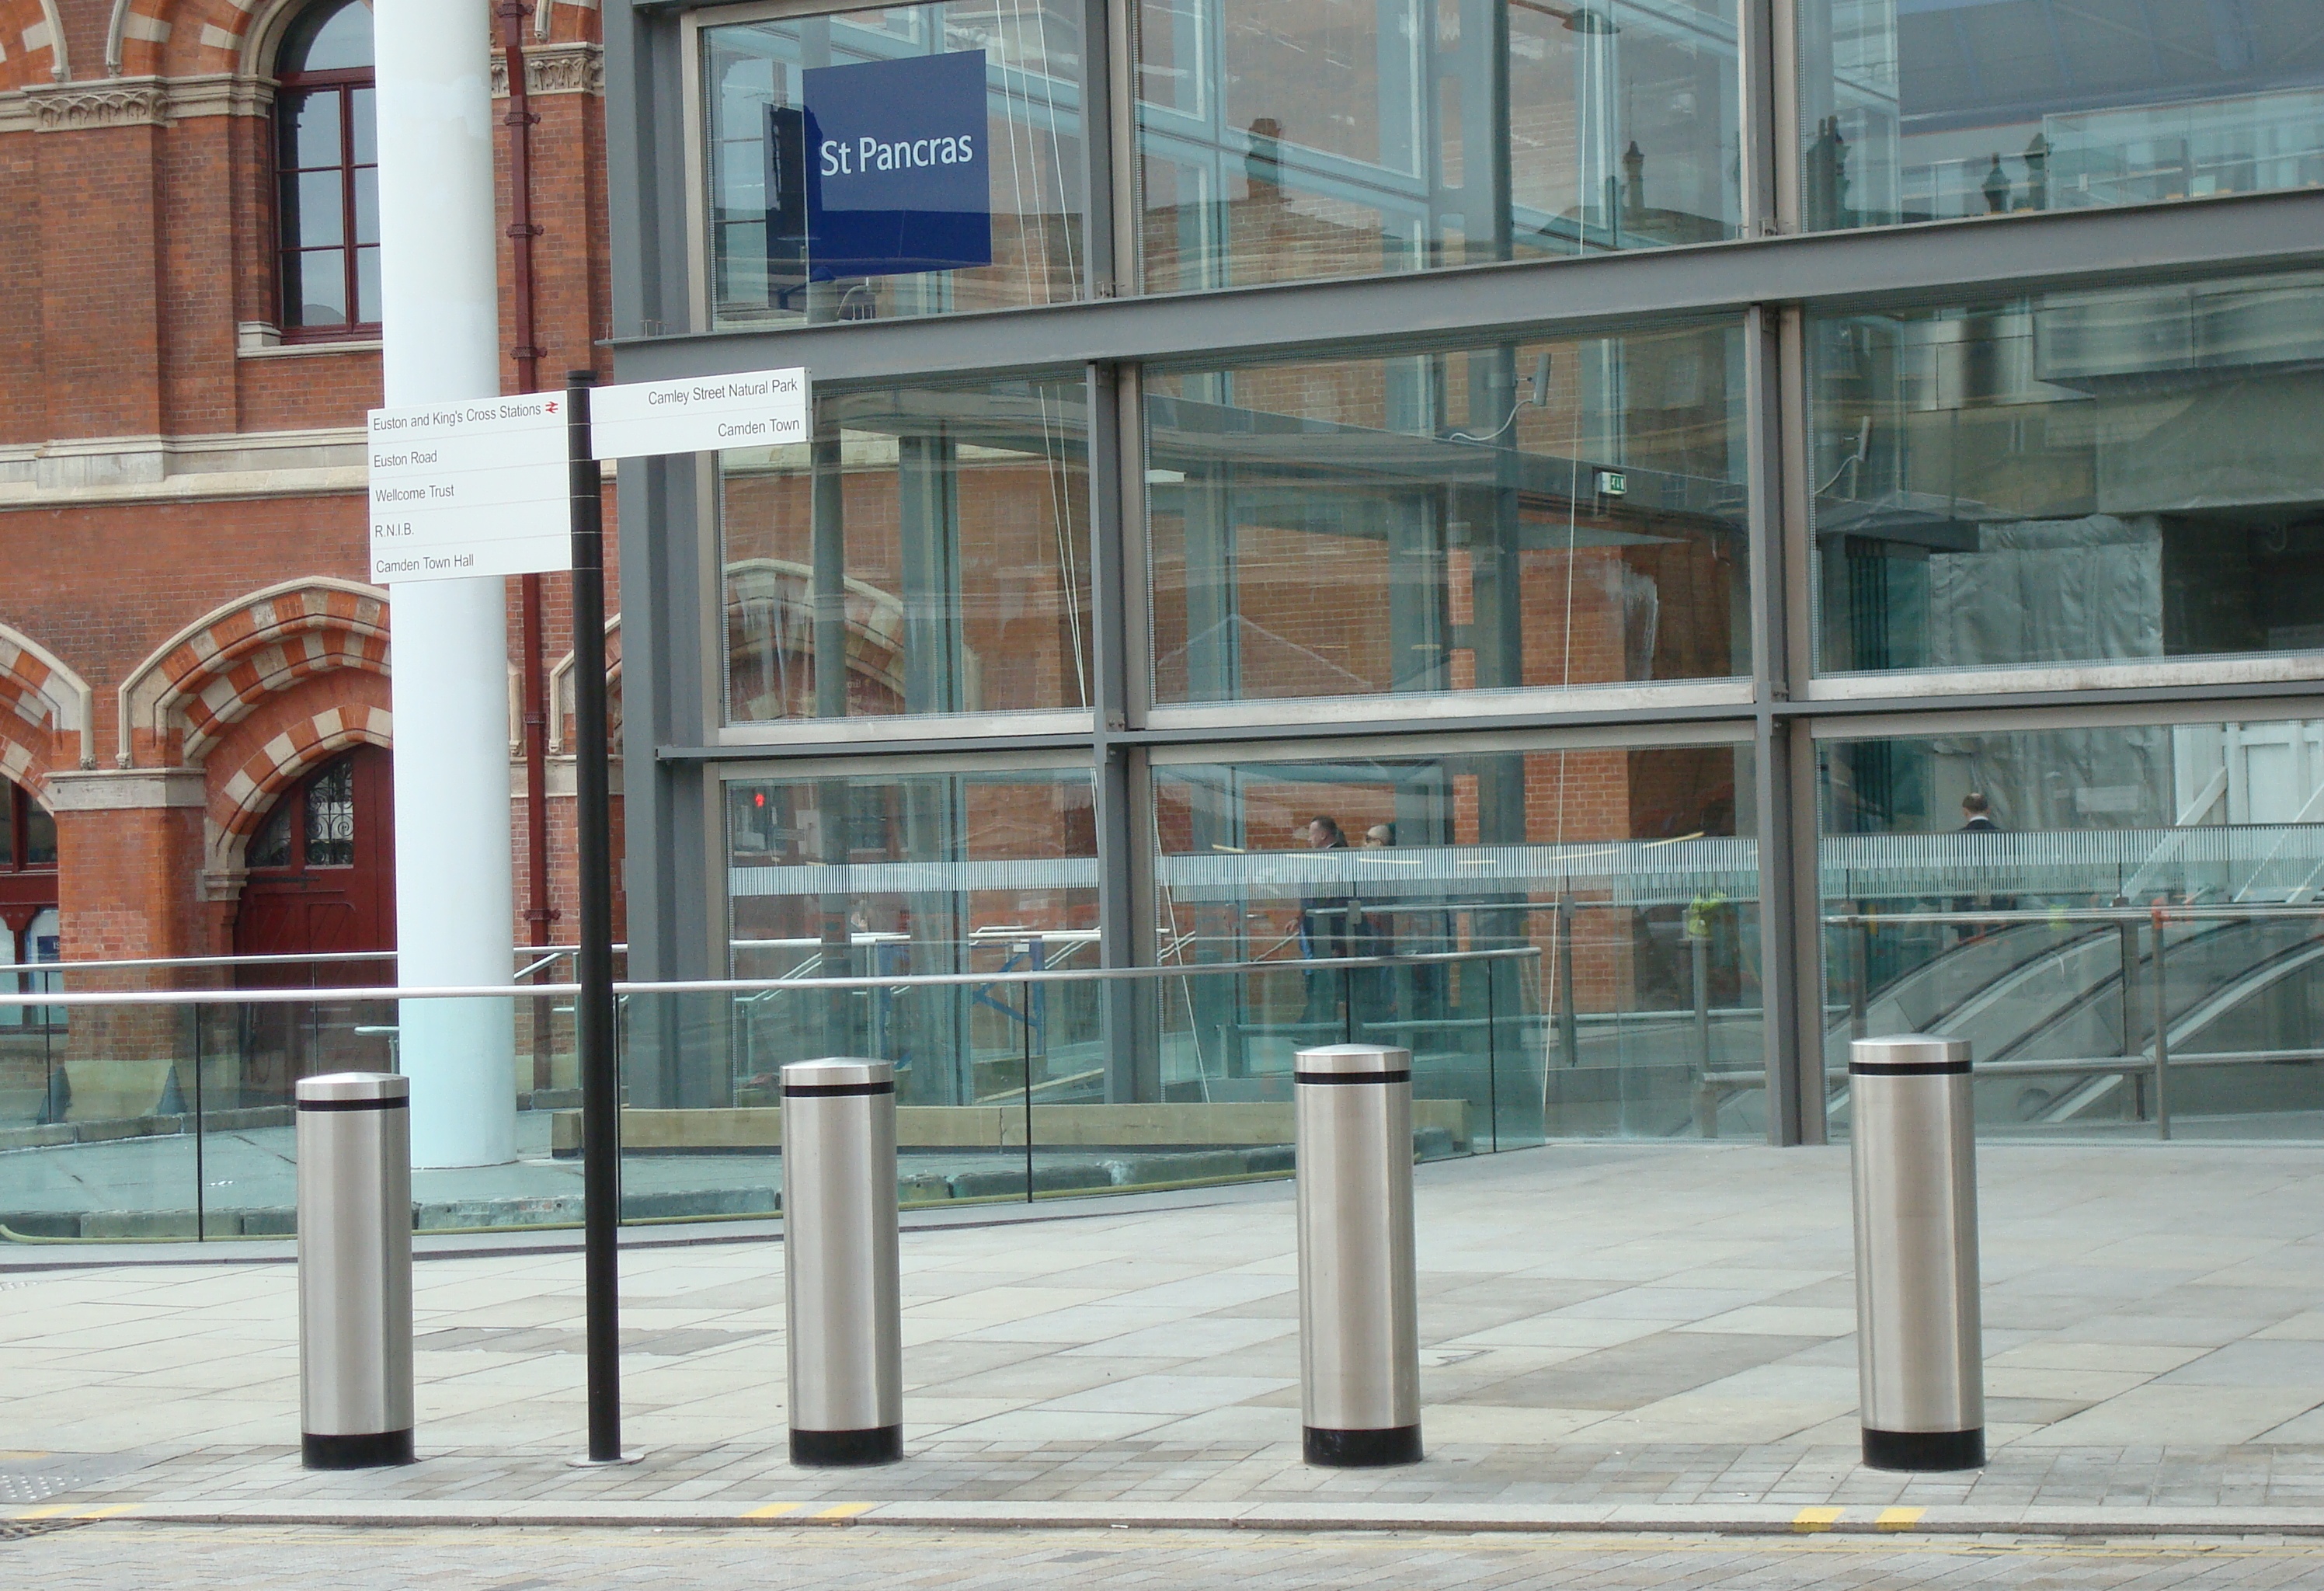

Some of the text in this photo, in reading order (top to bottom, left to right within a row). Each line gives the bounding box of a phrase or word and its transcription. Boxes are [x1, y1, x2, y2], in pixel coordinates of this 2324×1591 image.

[821, 134, 973, 176] St Pancras
[649, 378, 797, 405] Camley Street Natural Park
[374, 403, 541, 430] Euston and King's Cross Stations
[718, 419, 799, 437] Camden Town
[374, 451, 437, 468] Euston Road
[375, 485, 454, 502] Wellcome Trust
[375, 523, 414, 538] R.N.I.B.
[376, 554, 474, 573] Camden Town Hall
